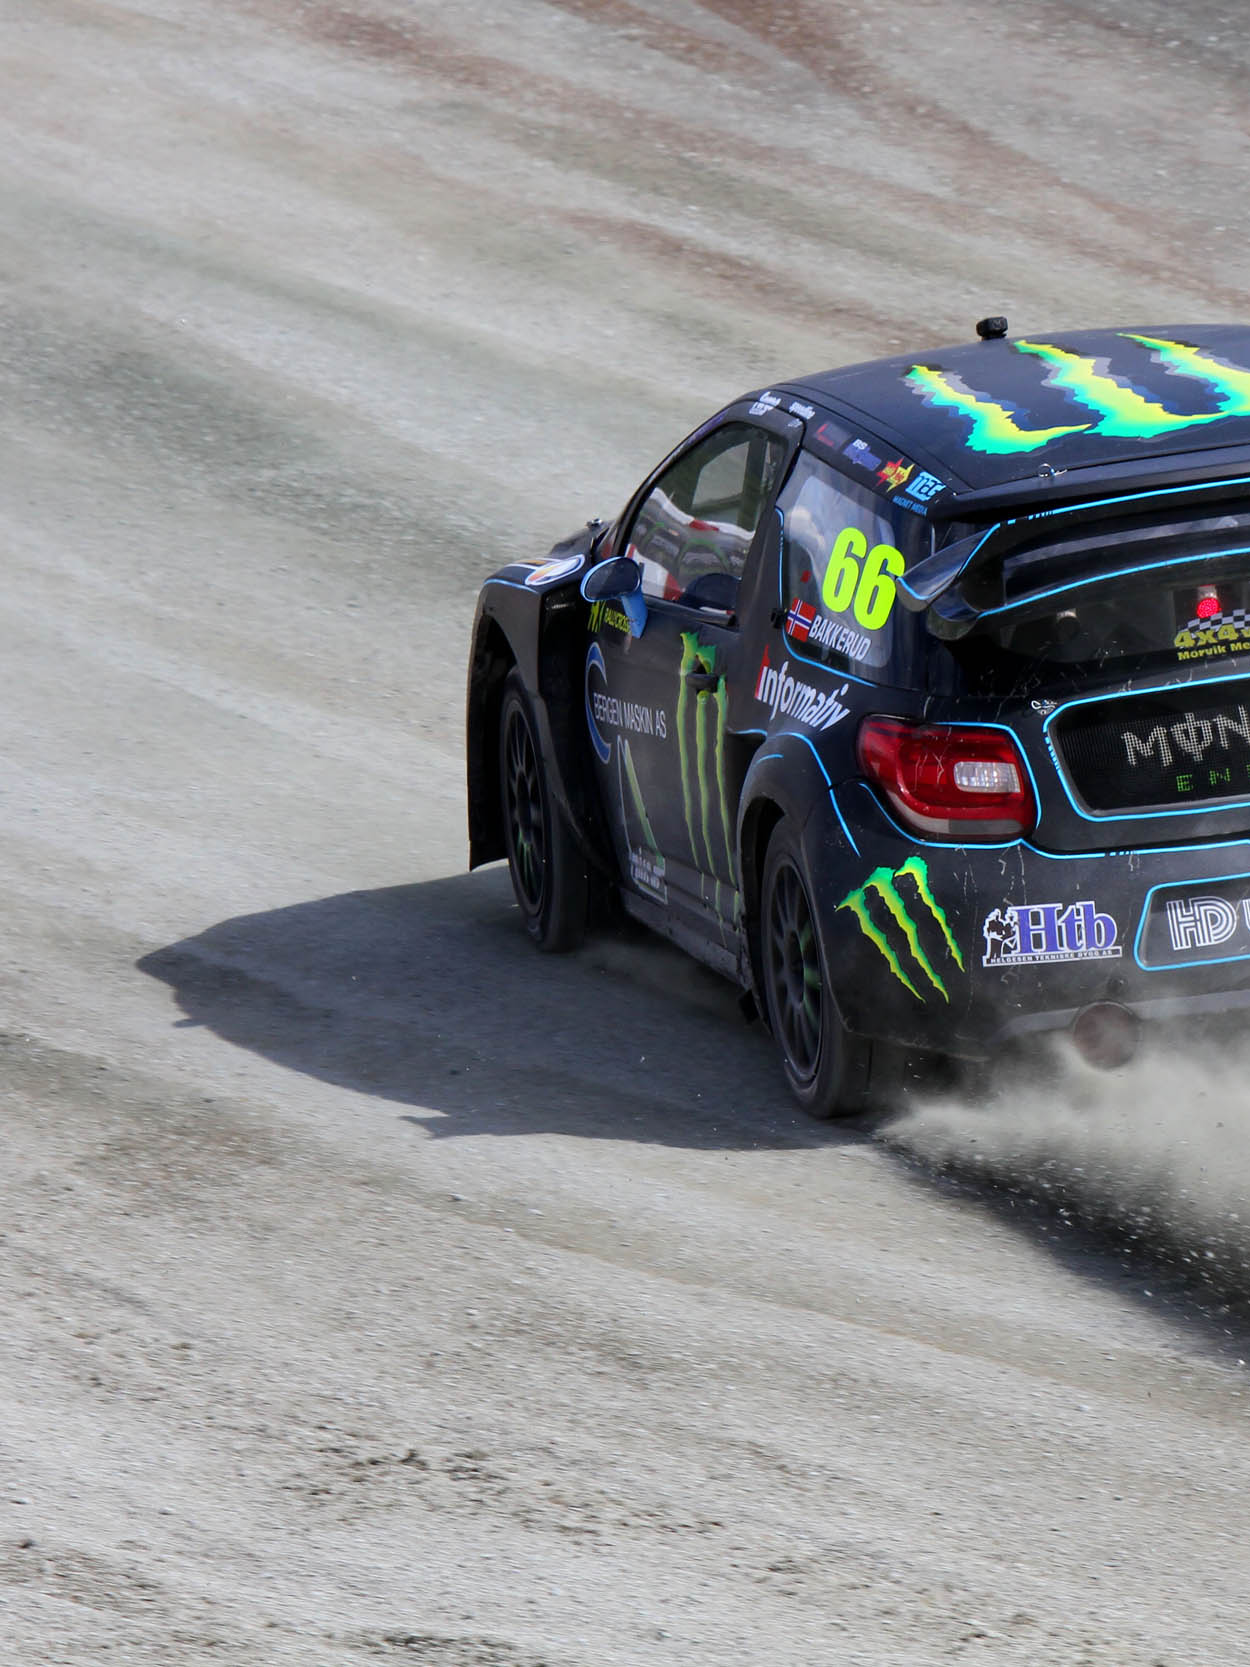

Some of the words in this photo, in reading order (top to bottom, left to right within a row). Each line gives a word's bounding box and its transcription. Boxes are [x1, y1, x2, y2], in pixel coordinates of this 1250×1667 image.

[822, 527, 905, 630] 66
[809, 615, 872, 661] BAKKERUD
[1177, 645, 1227, 661] Morvik
[593, 692, 623, 727] BERGEN
[623, 701, 654, 736] MASKIN
[655, 709, 667, 739] AS
[1007, 901, 1118, 954] Htb
[1166, 895, 1238, 951] HD
